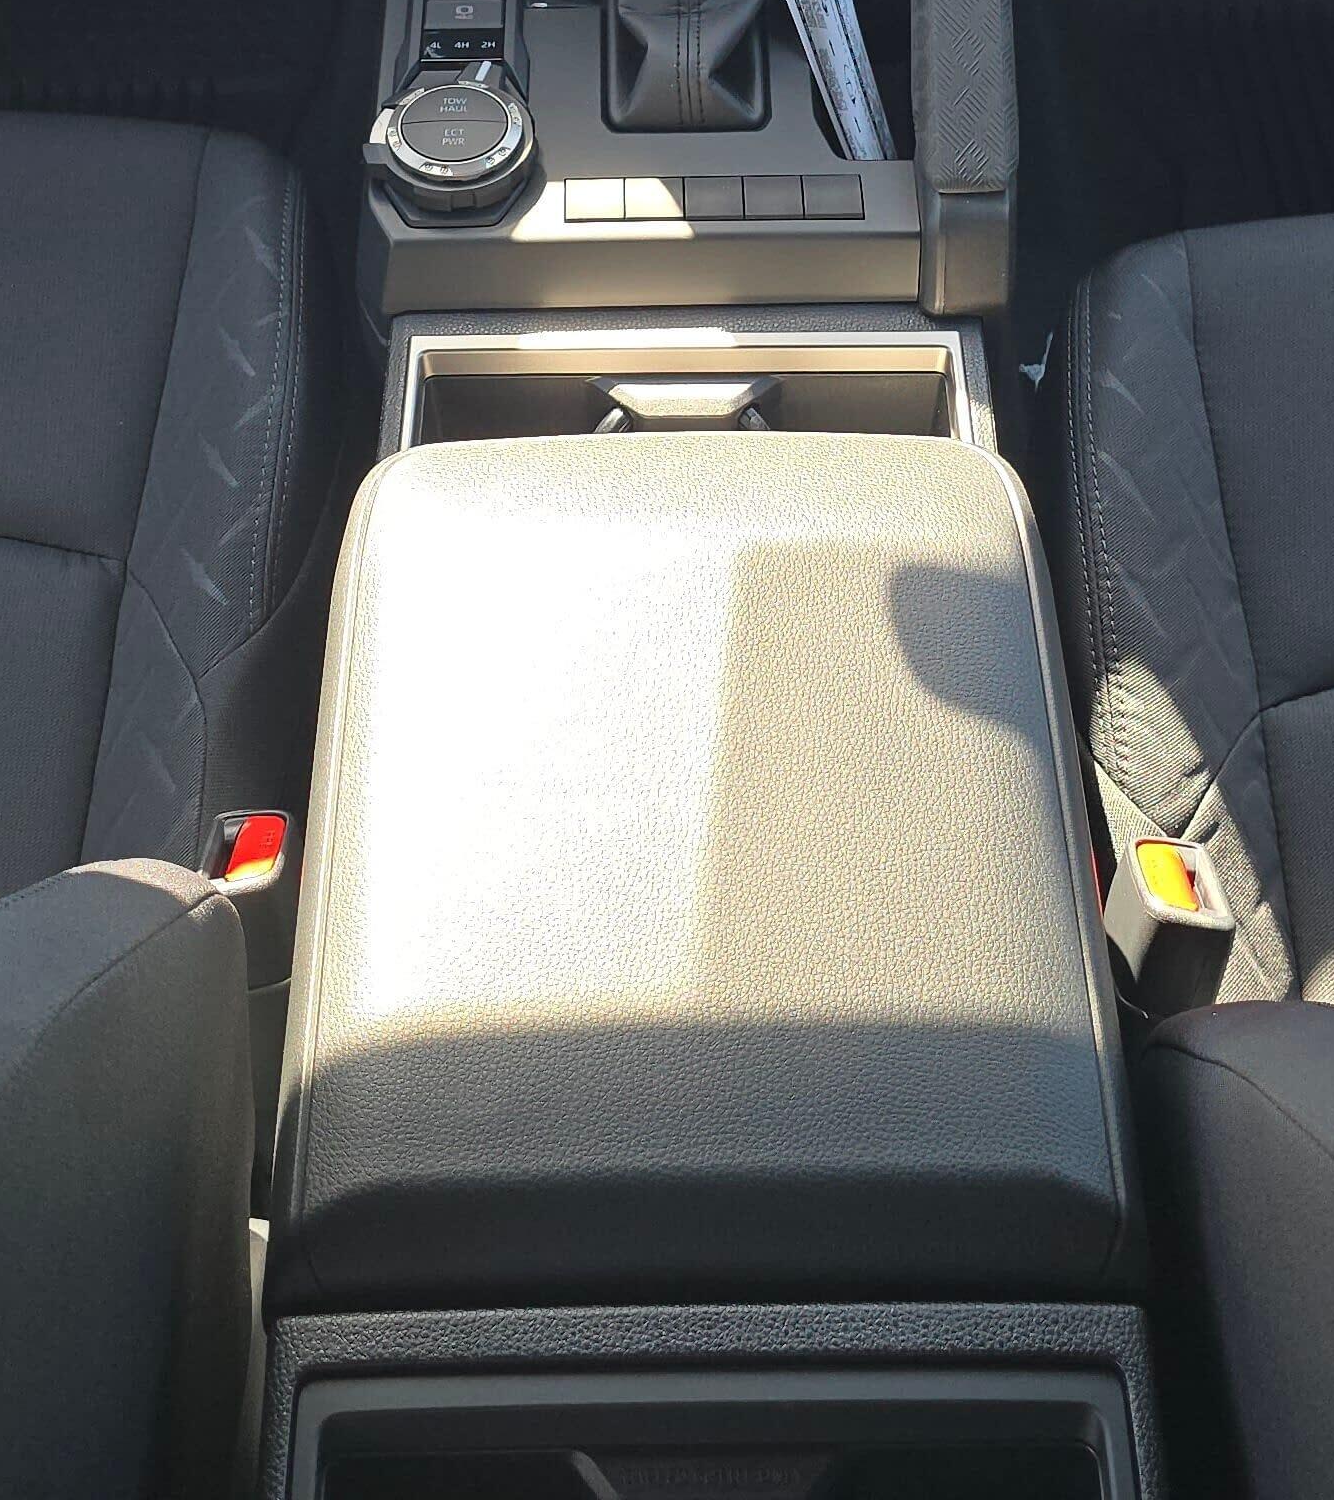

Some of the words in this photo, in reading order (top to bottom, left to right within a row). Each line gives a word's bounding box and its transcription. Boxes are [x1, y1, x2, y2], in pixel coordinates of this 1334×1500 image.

[430, 41, 442, 49] 4L
[454, 41, 470, 49] 4H
[481, 41, 496, 49] 2H
[443, 97, 467, 105] TOW
[439, 105, 467, 113] HAUL
[442, 138, 465, 146] PWR
